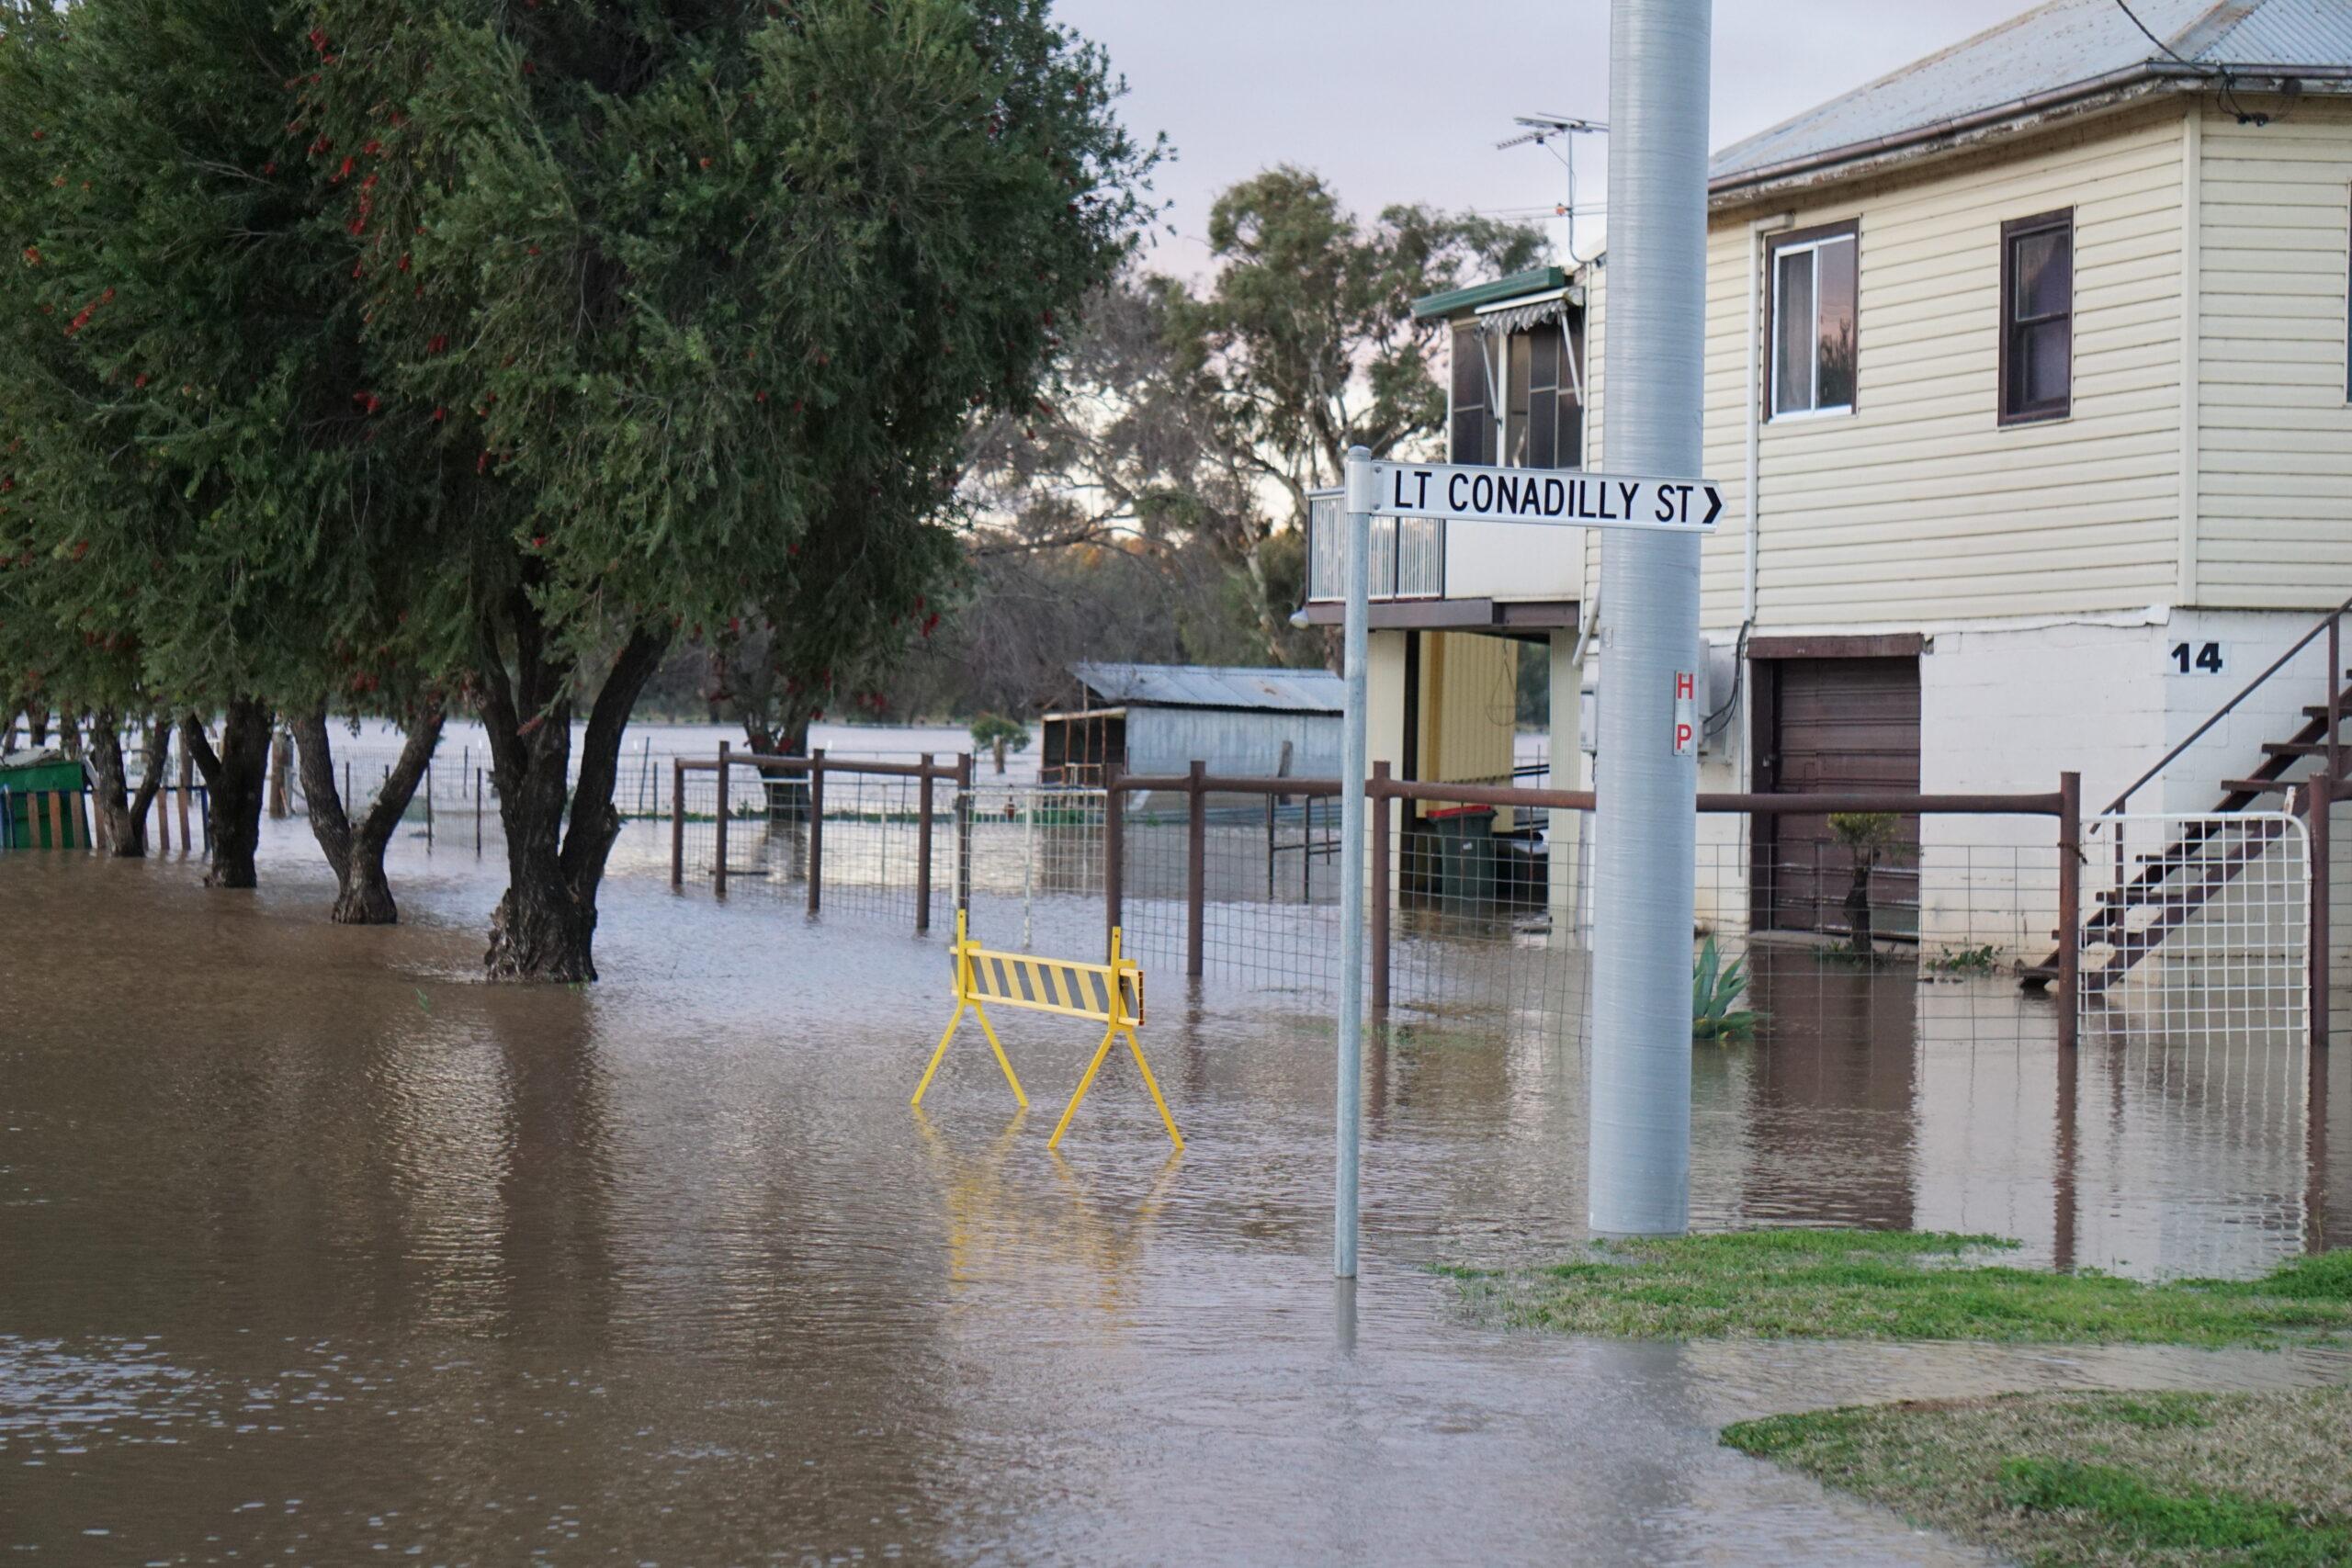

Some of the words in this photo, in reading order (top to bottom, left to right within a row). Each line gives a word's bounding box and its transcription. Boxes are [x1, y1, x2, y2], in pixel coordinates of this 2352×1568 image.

[1394, 469, 1432, 510] LT
[1448, 472, 1640, 521] CONADILLY
[1655, 483, 1693, 523] ST
[2171, 642, 2222, 673] 14
